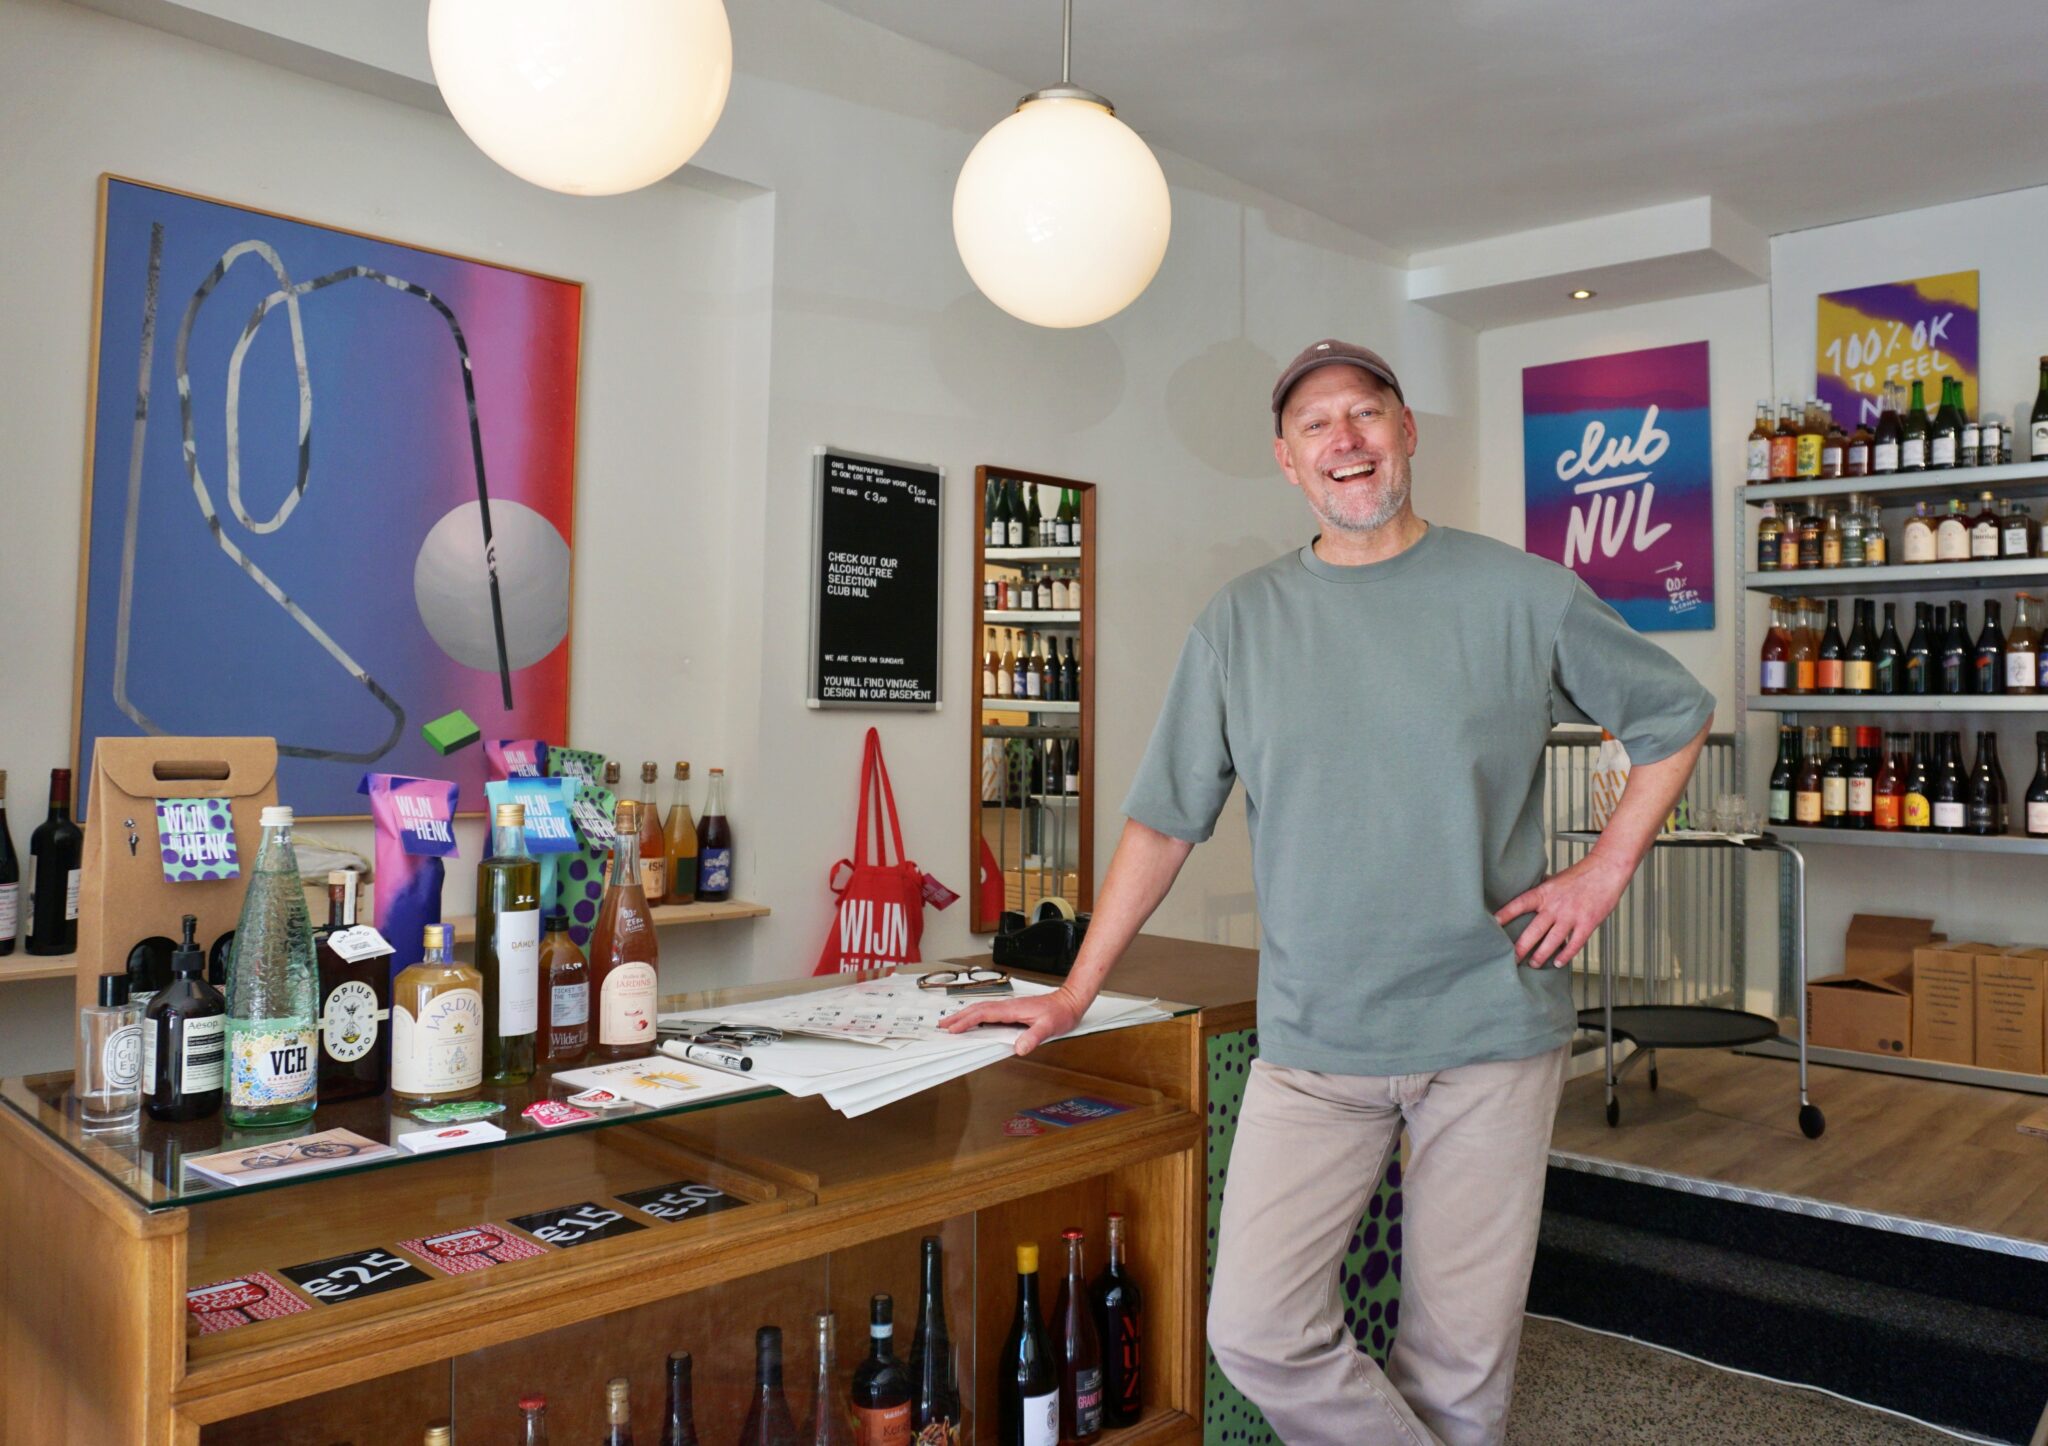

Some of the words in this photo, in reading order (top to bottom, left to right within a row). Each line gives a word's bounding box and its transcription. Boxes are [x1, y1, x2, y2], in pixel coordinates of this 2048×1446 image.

[1825, 320, 1904, 377] 100%
[1911, 311, 1954, 351] OK
[1851, 370, 1875, 392] TO
[1886, 350, 1949, 382] FEEL
[1556, 404, 1670, 481] club
[839, 470, 851, 479] OOK
[875, 477, 891, 485] KOOP
[892, 480, 907, 488] VOOR
[831, 486, 845, 494] TOTE
[846, 488, 858, 496] BAG
[914, 496, 926, 504] PER
[926, 498, 937, 506] VEL
[1563, 482, 1672, 569] NUL
[828, 551, 859, 564] CHECK
[860, 555, 877, 566] OUT
[880, 557, 898, 568] OUR
[828, 562, 893, 579] ALCOHOLFREE
[828, 573, 877, 588] SELECTION
[827, 584, 850, 596] CLUB
[852, 587, 870, 598] NUL
[851, 655, 867, 663] OPEN
[869, 656, 877, 664] ON
[879, 657, 904, 665] SUNDAYS
[824, 675, 841, 686] YOU
[843, 676, 862, 687] WILL
[863, 677, 884, 688] FIND
[885, 678, 919, 690] VINTAGE
[823, 687, 856, 698] DESIGN
[859, 688, 868, 698] IN
[870, 689, 887, 699] OUR
[889, 690, 931, 700] BASEMENT
[395, 796, 433, 818] WIJN
[163, 806, 210, 833] WIJN
[532, 817, 570, 838] HENK
[414, 819, 452, 843] HENK
[182, 833, 231, 861] HENK
[841, 899, 908, 957] WIJN
[332, 985, 372, 1003] OPIUS
[329, 1036, 371, 1057] AMARO
[550, 1032, 578, 1046] Wilder
[270, 1046, 308, 1076] VCH
[640, 1184, 724, 1218] €50
[531, 1205, 624, 1242] €15
[300, 1252, 412, 1298] €25
